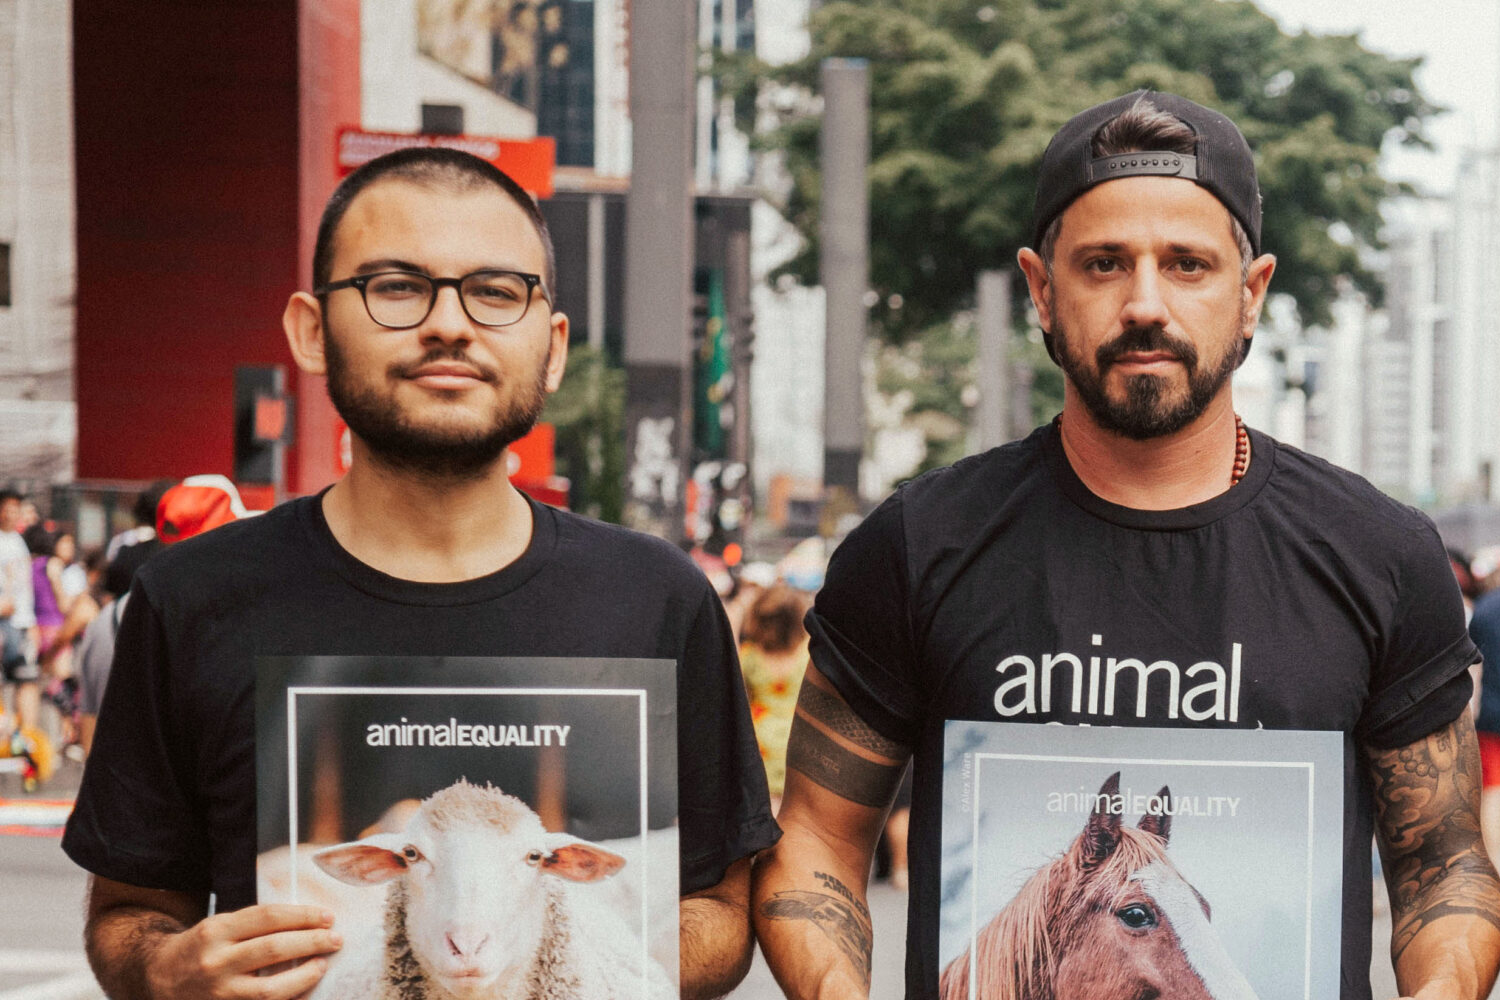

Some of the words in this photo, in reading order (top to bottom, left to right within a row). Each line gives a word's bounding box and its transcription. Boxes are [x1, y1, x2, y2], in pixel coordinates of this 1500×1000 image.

[993, 634, 1242, 723] animal
[366, 717, 571, 748] animalEQUALITY
[1047, 786, 1241, 817] animalEQUALITY
